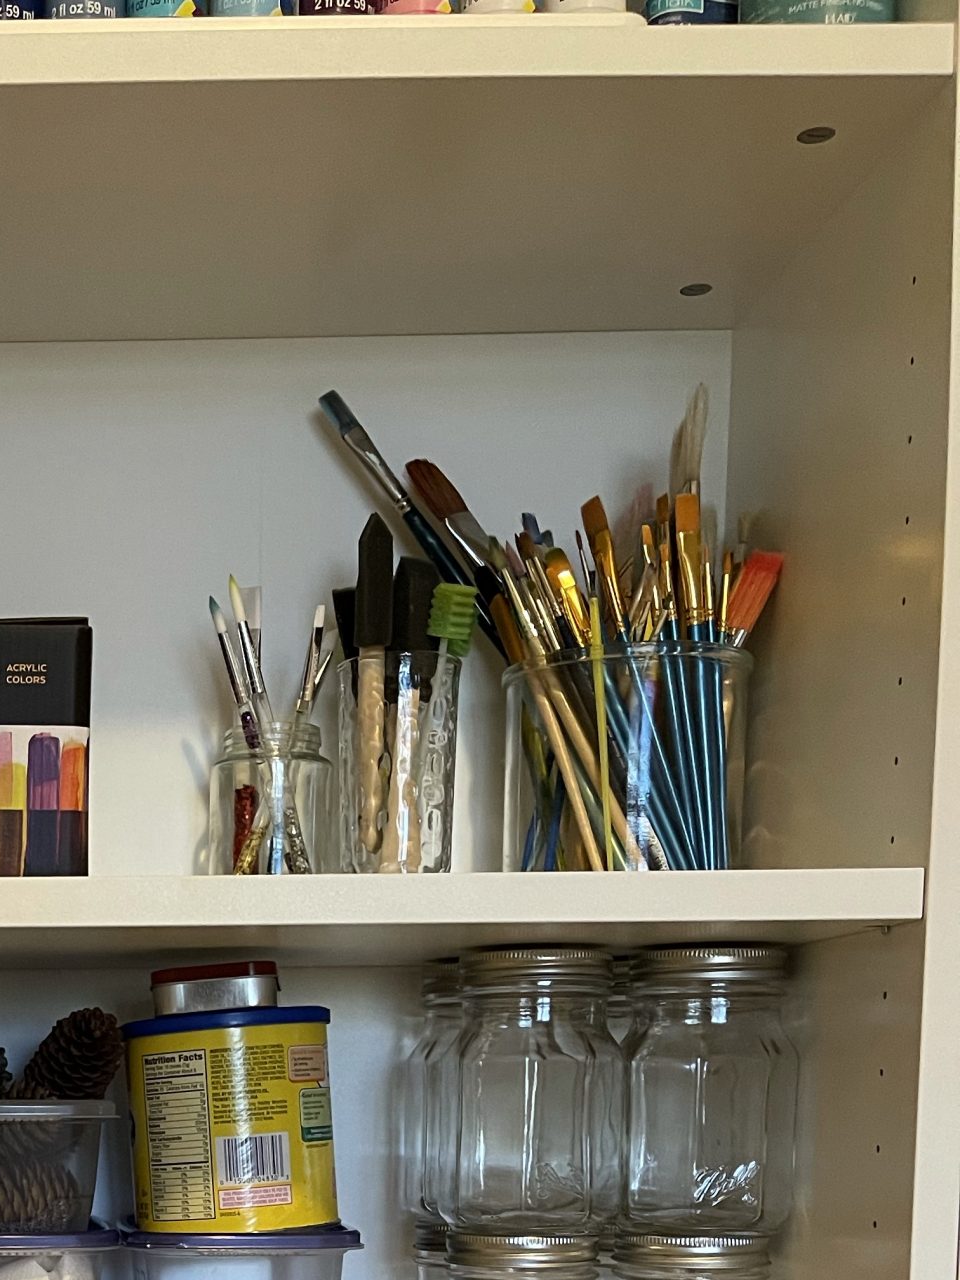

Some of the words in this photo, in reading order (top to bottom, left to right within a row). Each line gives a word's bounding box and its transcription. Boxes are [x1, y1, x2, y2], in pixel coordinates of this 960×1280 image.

[59, 3, 66, 16] fl
[69, 3, 83, 14] oz
[87, 1, 101, 14] 59
[104, 6, 116, 18] ml
[314, 0, 323, 10] 2
[354, 0, 366, 11] 59
[6, 4, 20, 18] 59
[22, 10, 35, 20] ml
[6, 663, 47, 673] ACRYLIC
[6, 675, 46, 685] COLORS
[144, 1056, 176, 1066] Nutrition
[178, 1053, 204, 1063] Facts
